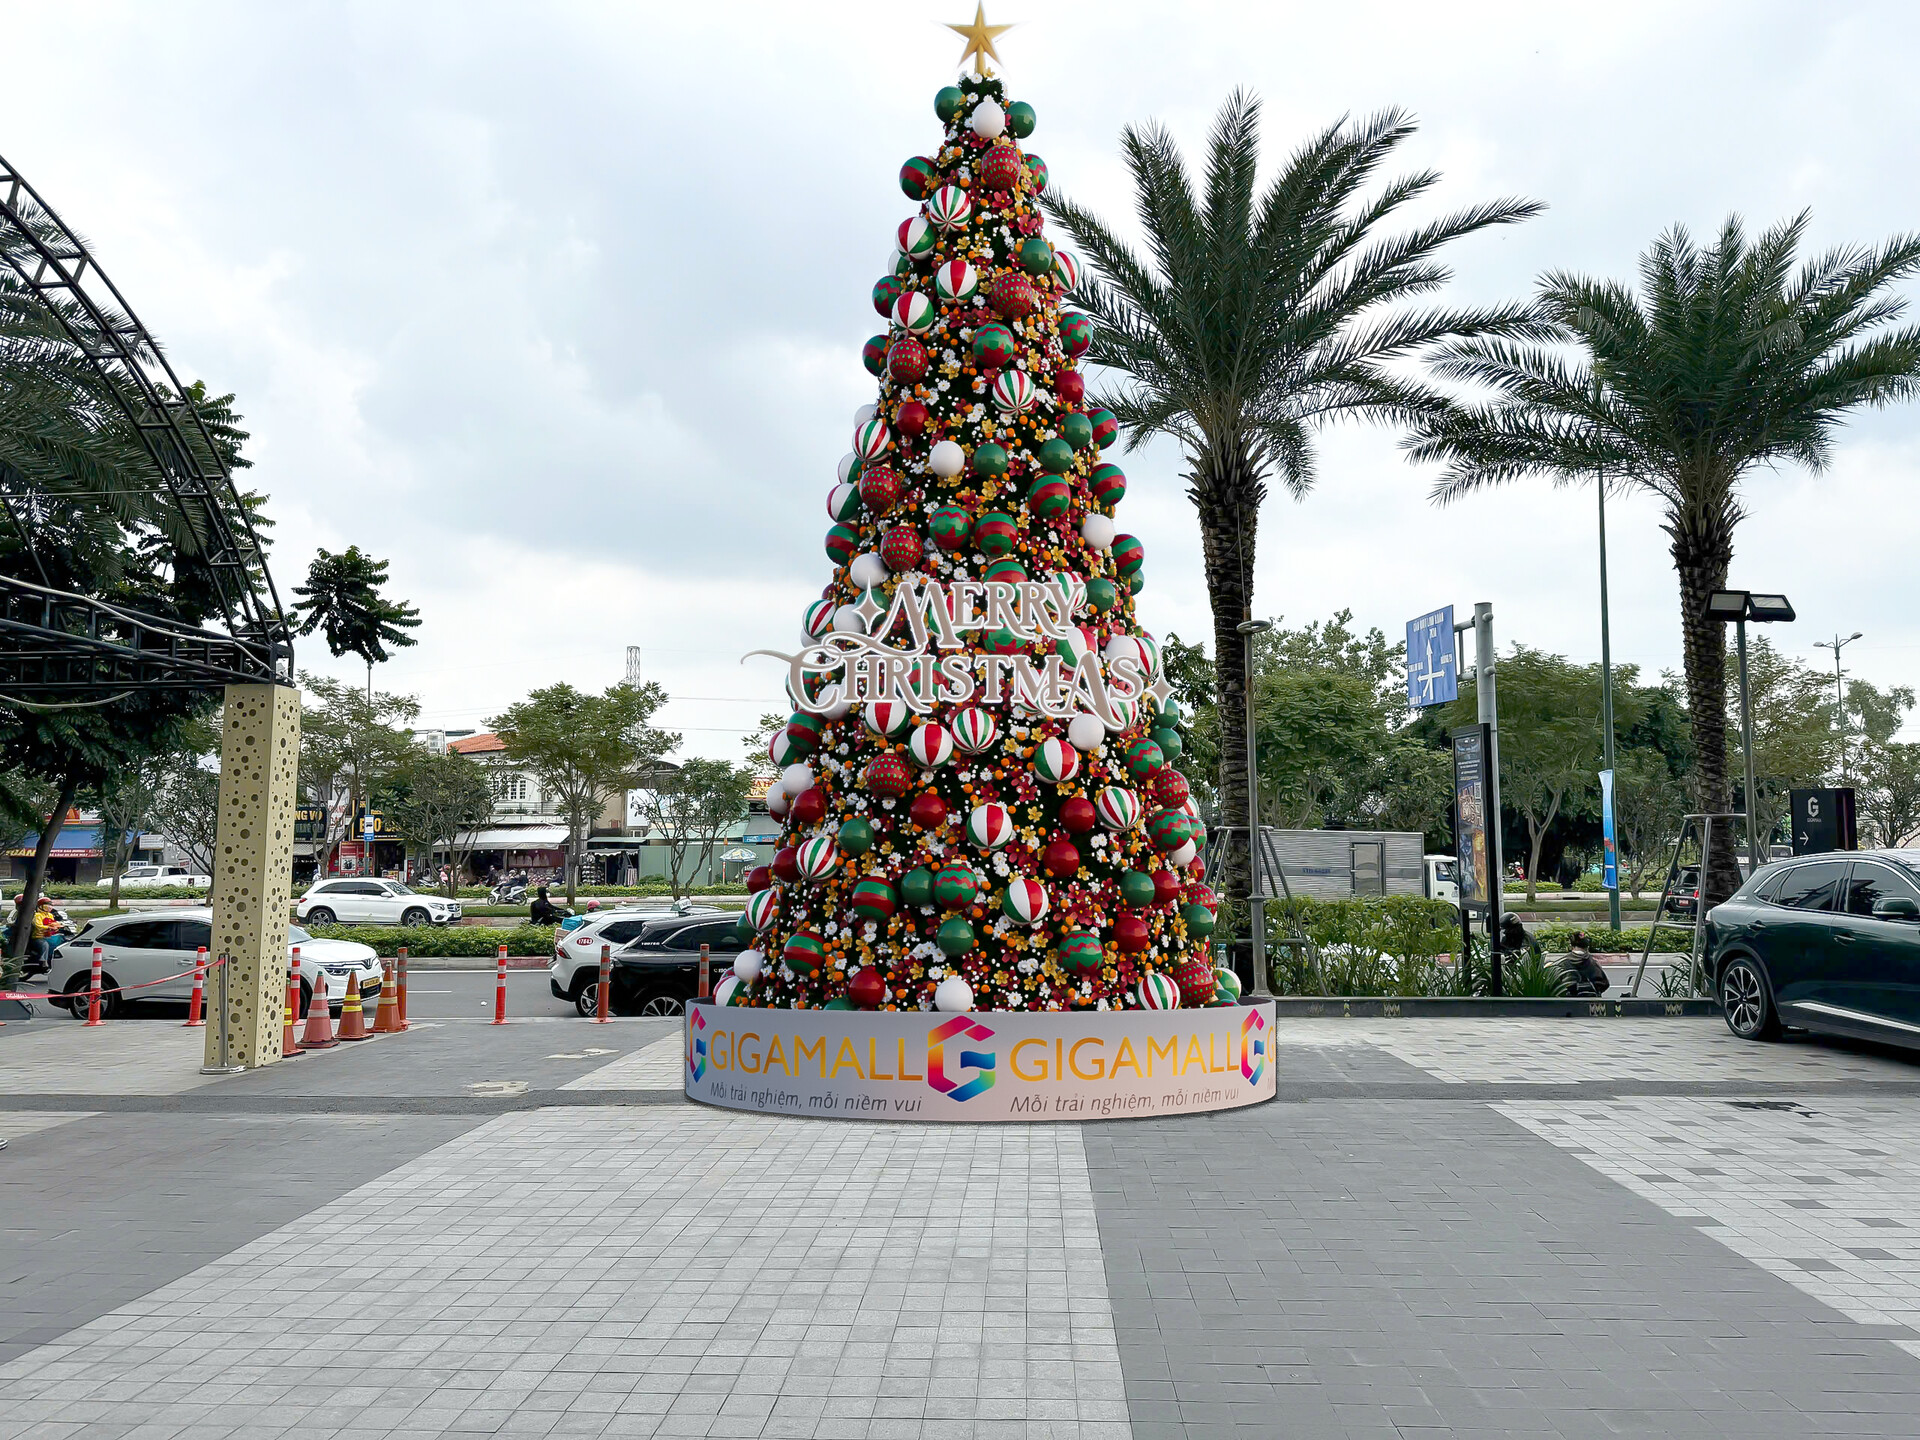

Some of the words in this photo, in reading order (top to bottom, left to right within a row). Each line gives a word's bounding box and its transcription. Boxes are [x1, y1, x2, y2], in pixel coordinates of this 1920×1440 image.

[822, 581, 1087, 656] MERRY
[741, 650, 1149, 731] CHRISTMAS
[710, 1029, 923, 1081] GIGAMALL
[1009, 1031, 1240, 1082] GIGAMALL
[751, 1087, 802, 1108] nghiệm,
[808, 1091, 839, 1109] mỗi
[844, 1093, 887, 1112] niềm
[895, 1096, 922, 1112] vui
[1010, 1094, 1049, 1113] Mỗi
[1055, 1093, 1085, 1112] trải
[1090, 1092, 1155, 1115] nghiệm,
[1161, 1088, 1189, 1107] mỗi
[1224, 1088, 1240, 1101] vui
